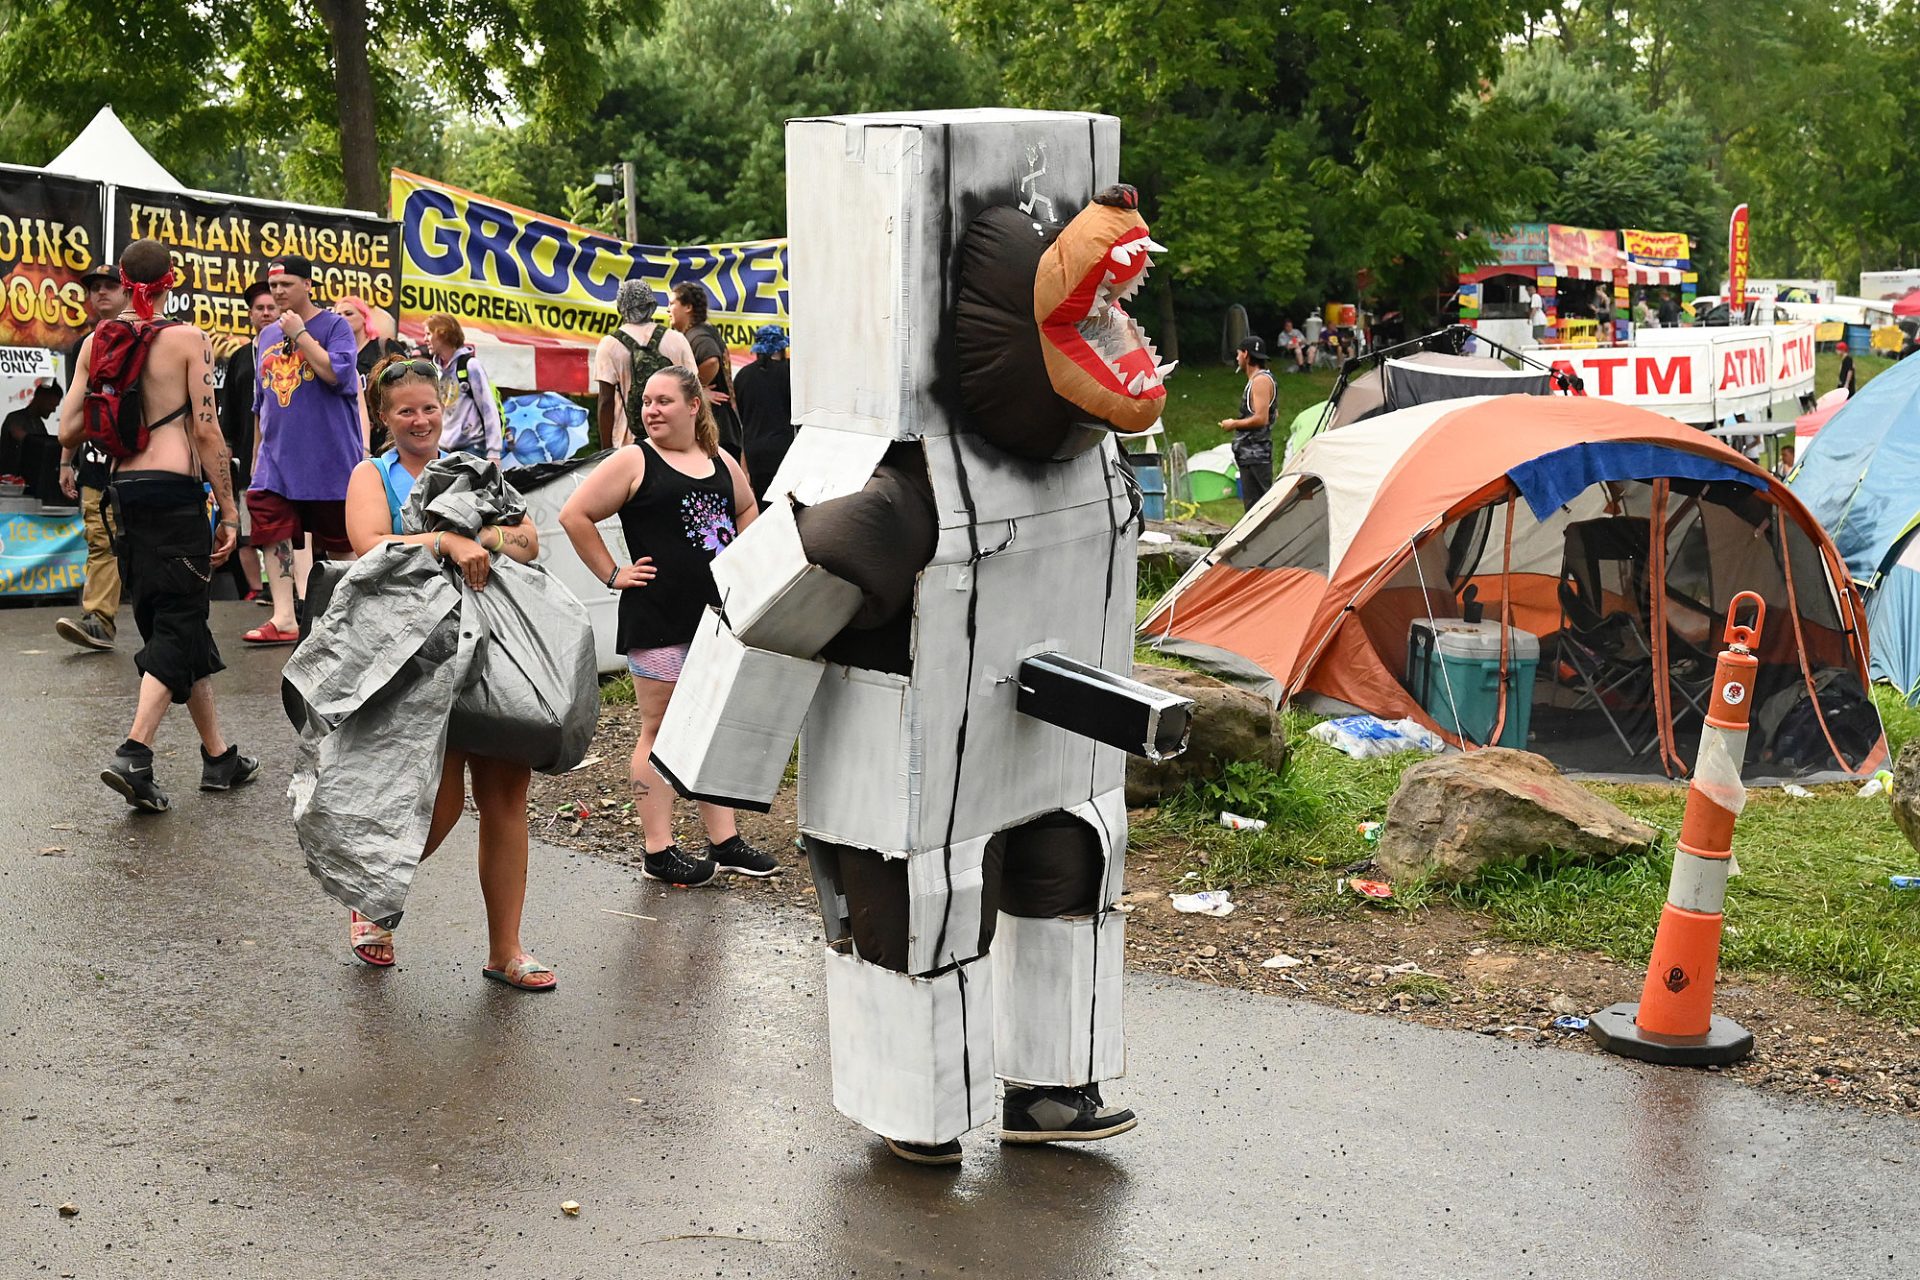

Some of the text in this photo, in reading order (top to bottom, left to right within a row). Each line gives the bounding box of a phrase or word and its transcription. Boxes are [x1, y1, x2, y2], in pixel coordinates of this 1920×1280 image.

[130, 203, 390, 268] ITALIAN SAUSAGE
[404, 189, 789, 316] GROCERIE
[170, 250, 394, 308] STEAK RGERS
[192, 293, 258, 336] BEE
[401, 285, 532, 324] SUNSCREEN
[1, 362, 37, 373] ONLY
[1549, 356, 1692, 396] ATM
[1718, 346, 1766, 390] ATM
[1778, 334, 1813, 380] ATM
[199, 412, 213, 424] 12
[9, 521, 80, 541] ICE COL
